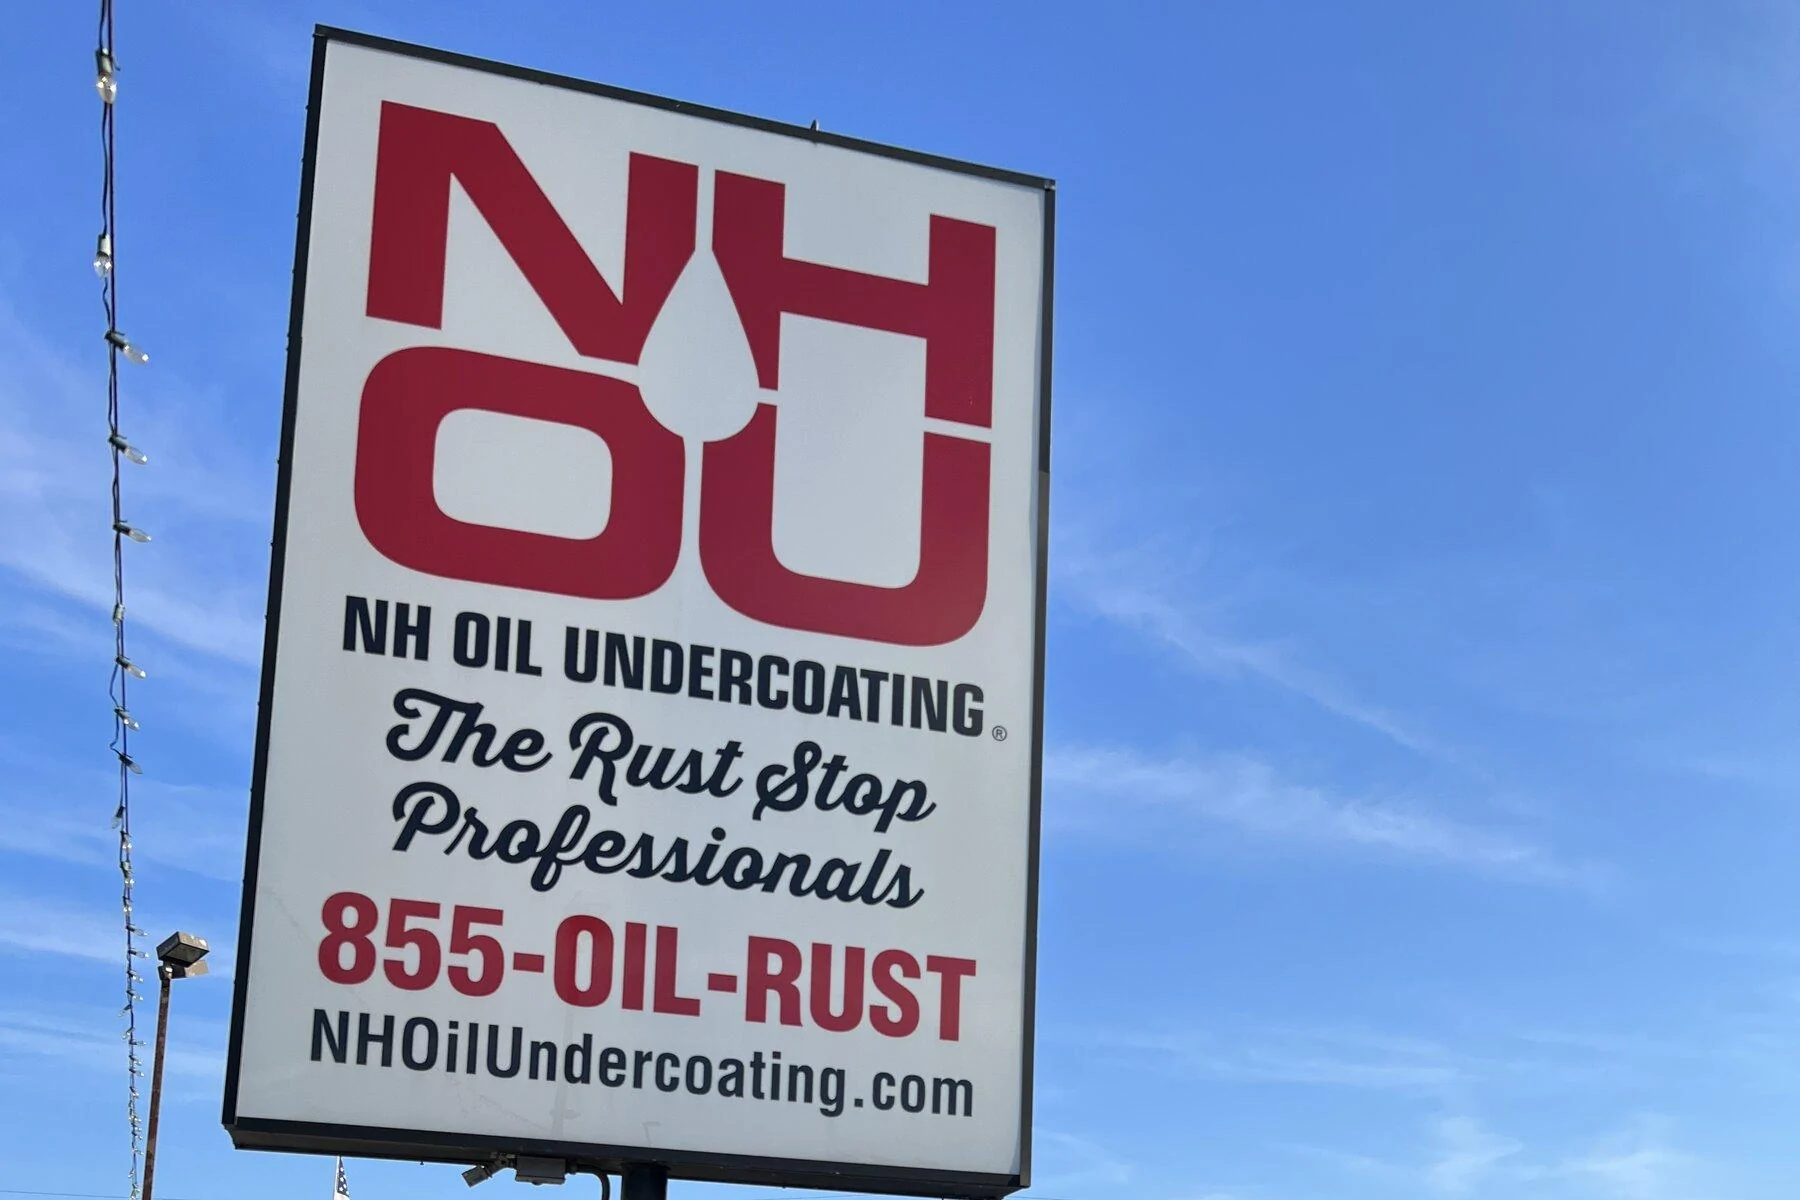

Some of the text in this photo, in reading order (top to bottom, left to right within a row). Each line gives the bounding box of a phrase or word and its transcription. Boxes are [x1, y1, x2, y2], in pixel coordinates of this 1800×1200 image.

[366, 100, 996, 429] NH
[354, 347, 992, 646] OU
[343, 595, 432, 662] NH
[454, 611, 542, 677] OIL
[564, 626, 984, 738] UNDERCOATING
[385, 688, 937, 834] The Rust Stop
[391, 781, 925, 909] Professionals
[318, 891, 977, 1042] 855-OIL-RUST
[310, 1008, 973, 1118] NHOilUndercoating.com
